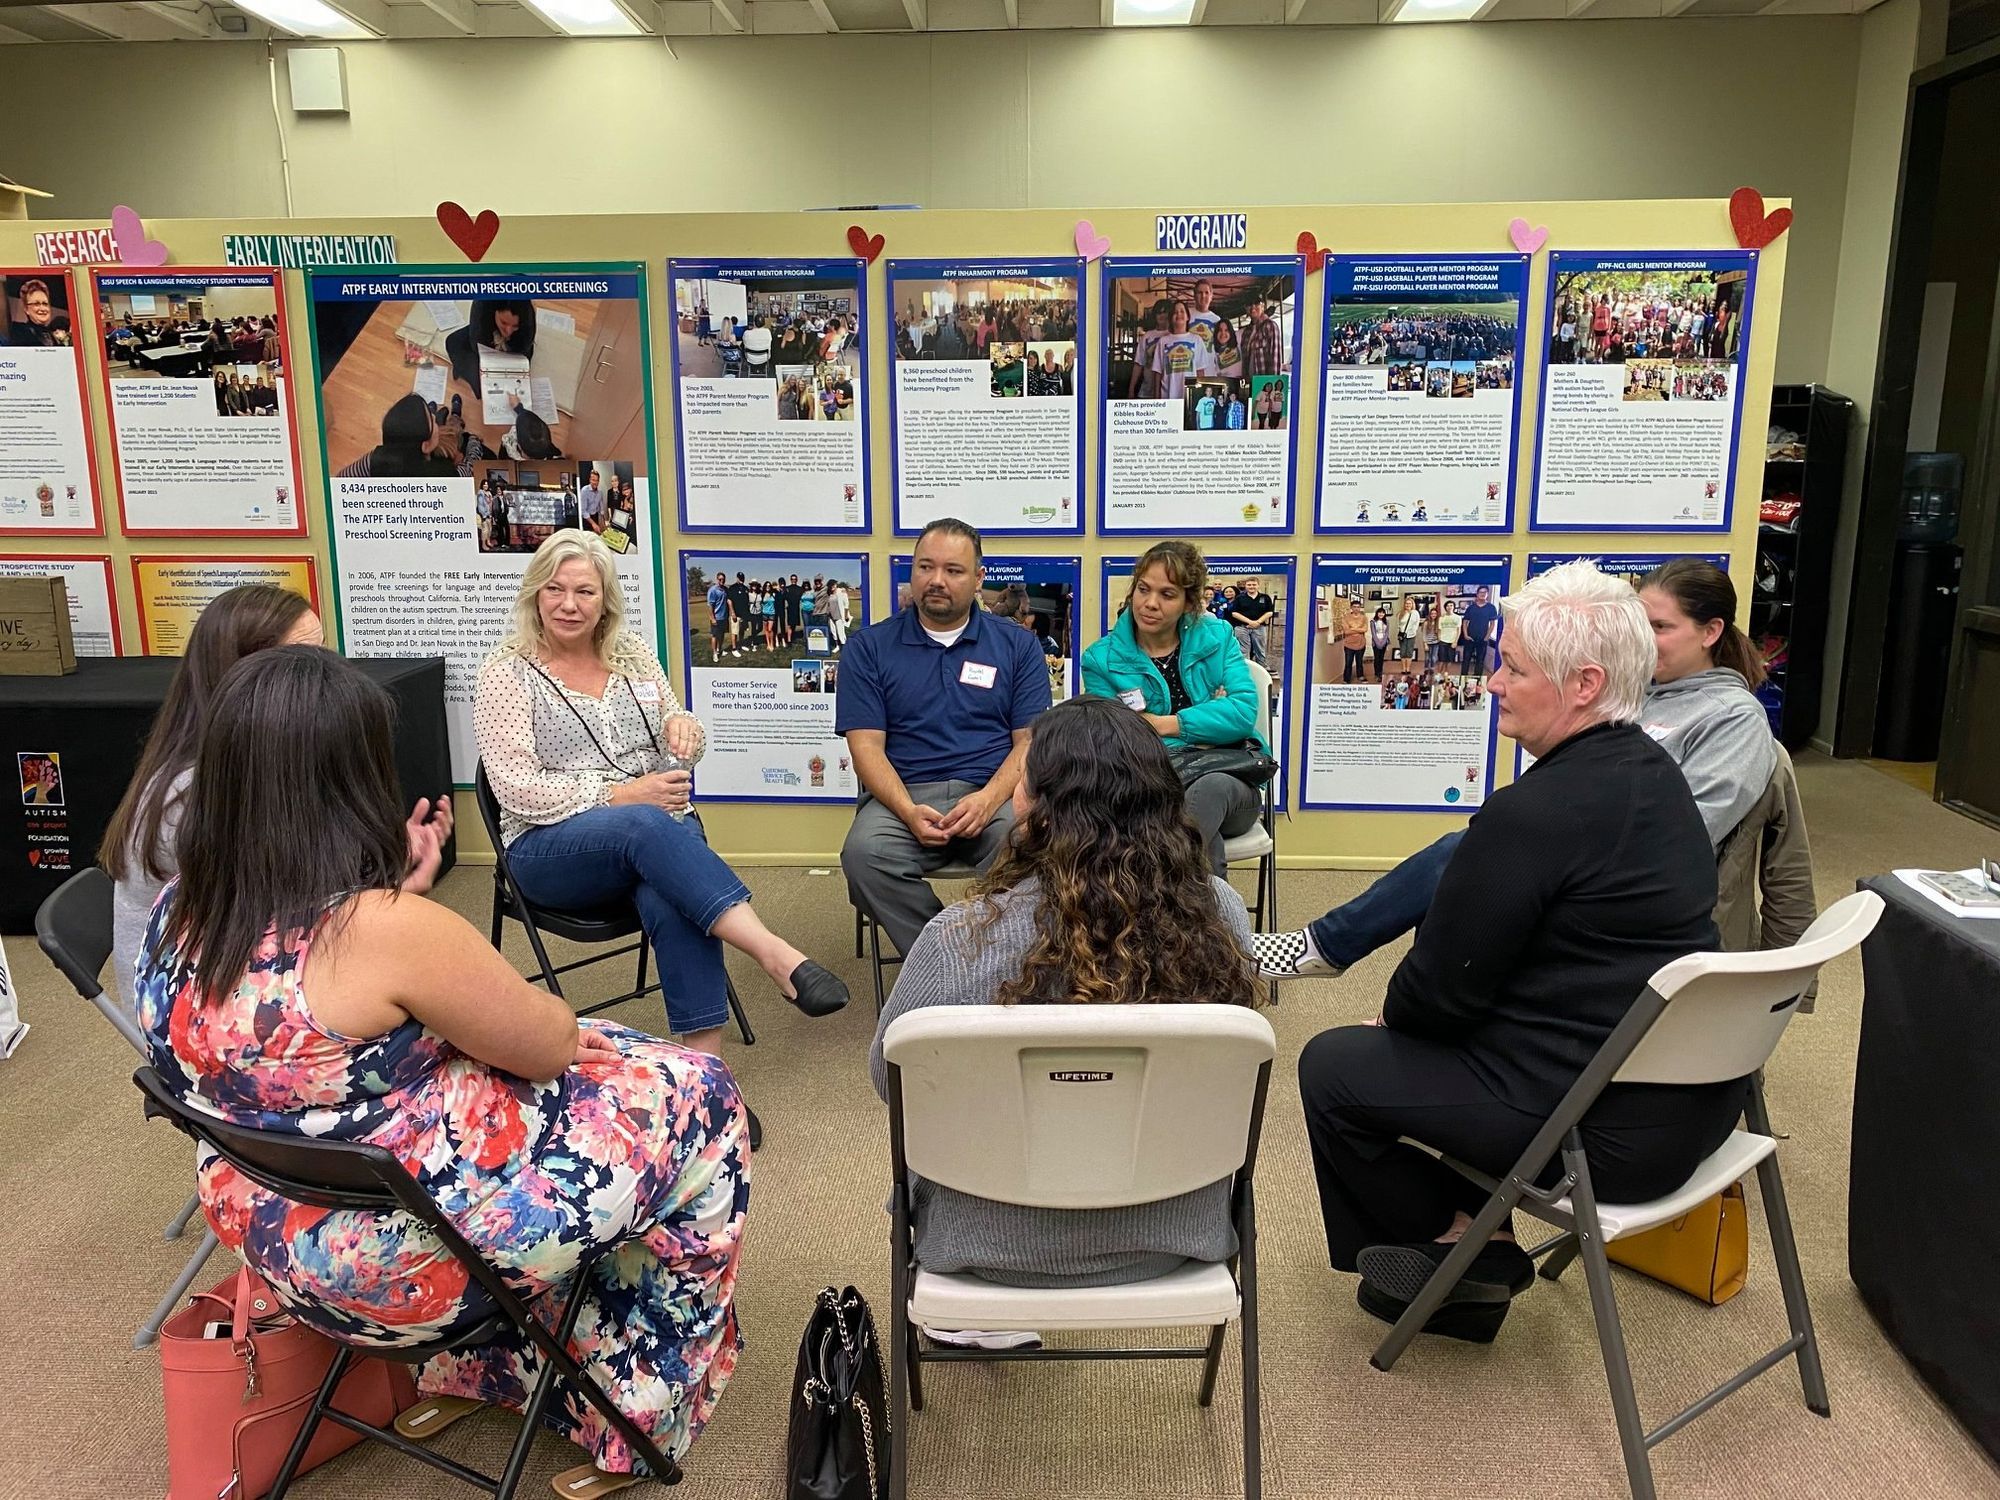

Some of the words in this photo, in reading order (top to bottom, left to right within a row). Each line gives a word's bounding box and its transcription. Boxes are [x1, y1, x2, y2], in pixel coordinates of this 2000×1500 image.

[1157, 214, 1245, 249] PROGRAMS
[35, 229, 122, 265] RESEARCH
[224, 236, 271, 266] EARLY
[276, 236, 396, 268] INTERVENTION
[342, 284, 366, 295] ATPF
[368, 283, 398, 294] EARLY
[401, 283, 478, 294] INTERVENTION
[480, 282, 541, 293] PRESCHOOL
[543, 281, 608, 292] SCREENINGS
[340, 483, 365, 493] 8,434
[367, 483, 424, 494] preschoolers
[426, 483, 447, 492] have
[342, 499, 364, 508] been
[366, 499, 406, 508] screened
[408, 498, 443, 510] through
[344, 514, 359, 523] The
[362, 514, 383, 523] ATPF
[385, 514, 407, 525] Early
[409, 514, 464, 523] Intervention
[345, 529, 388, 539] Preschool
[389, 530, 432, 540] Screening
[434, 530, 472, 540] Program
[358, 571, 376, 580] 2006,
[443, 571, 459, 579] FREE
[463, 572, 479, 580] Early
[377, 582, 391, 590] free
[394, 584, 428, 592] screenings
[432, 582, 441, 590] for
[445, 584, 475, 592] language
[350, 594, 385, 602] preschools
[388, 594, 425, 603] throughout
[464, 594, 480, 603] Early
[633, 595, 640, 603] of
[350, 605, 377, 613] children
[389, 605, 400, 613] the
[460, 605, 473, 613] The
[474, 607, 509, 615] screenings
[711, 680, 748, 688] Customer
[750, 680, 777, 688] Service
[712, 691, 735, 699] Realty
[753, 702, 788, 710] $200,000
[43, 855, 69, 863] LOVE
